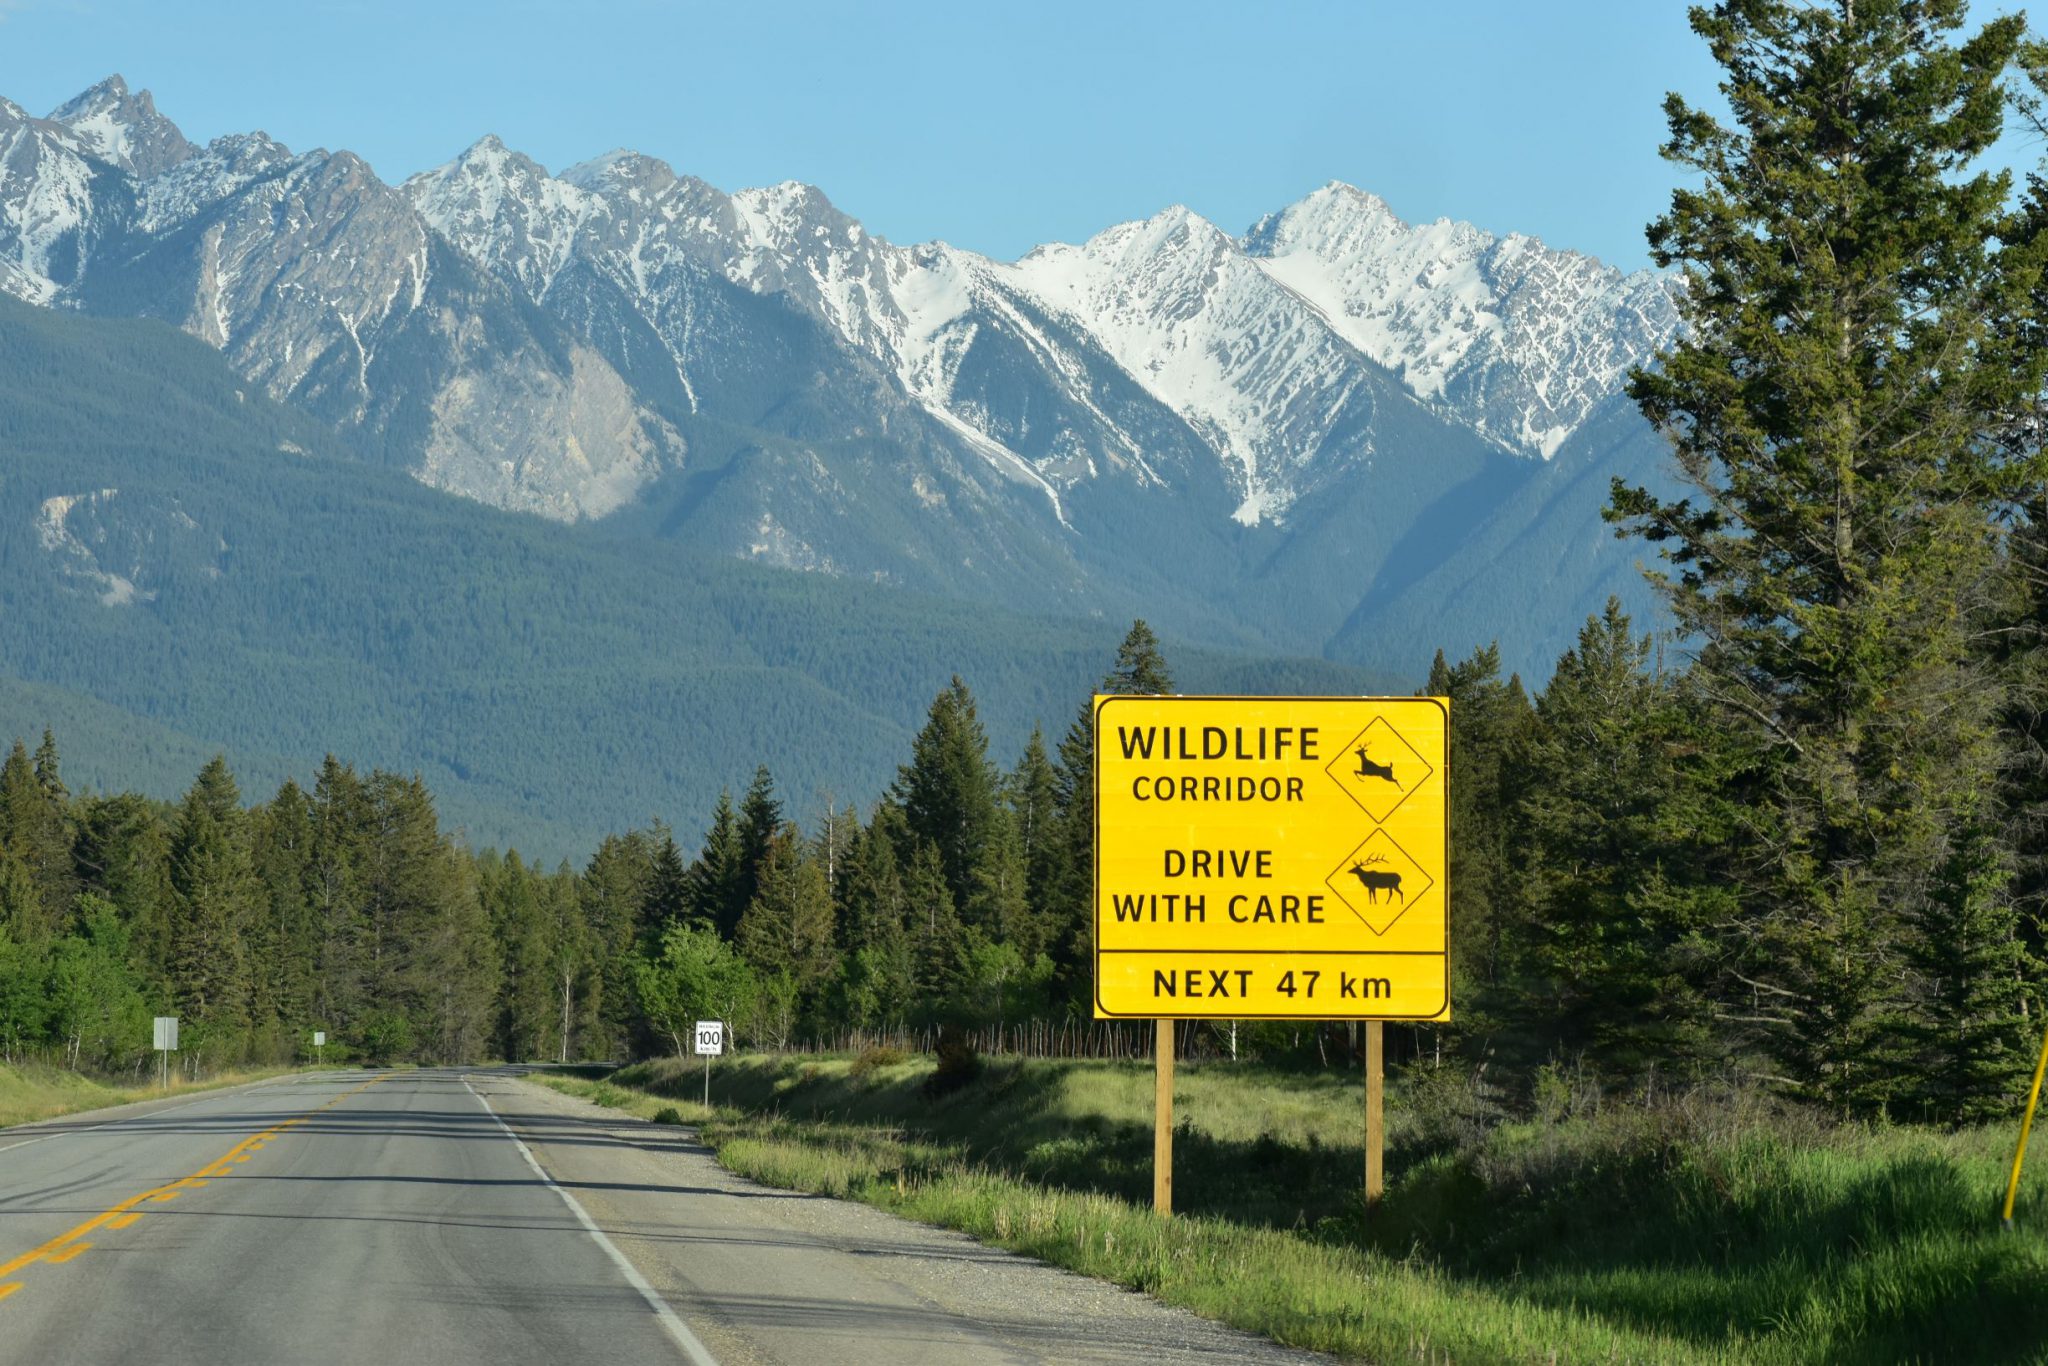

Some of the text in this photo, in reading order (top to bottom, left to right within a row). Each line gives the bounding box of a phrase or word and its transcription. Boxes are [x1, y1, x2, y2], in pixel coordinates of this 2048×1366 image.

[1118, 726, 1320, 760] WILDLIFE
[1132, 776, 1304, 802] CORRIDOR
[1164, 849, 1273, 878] DRIVE
[1112, 894, 1325, 924] WITH CARE
[1154, 970, 1392, 999] NEXT 47 km
[698, 1031, 720, 1045] 100
